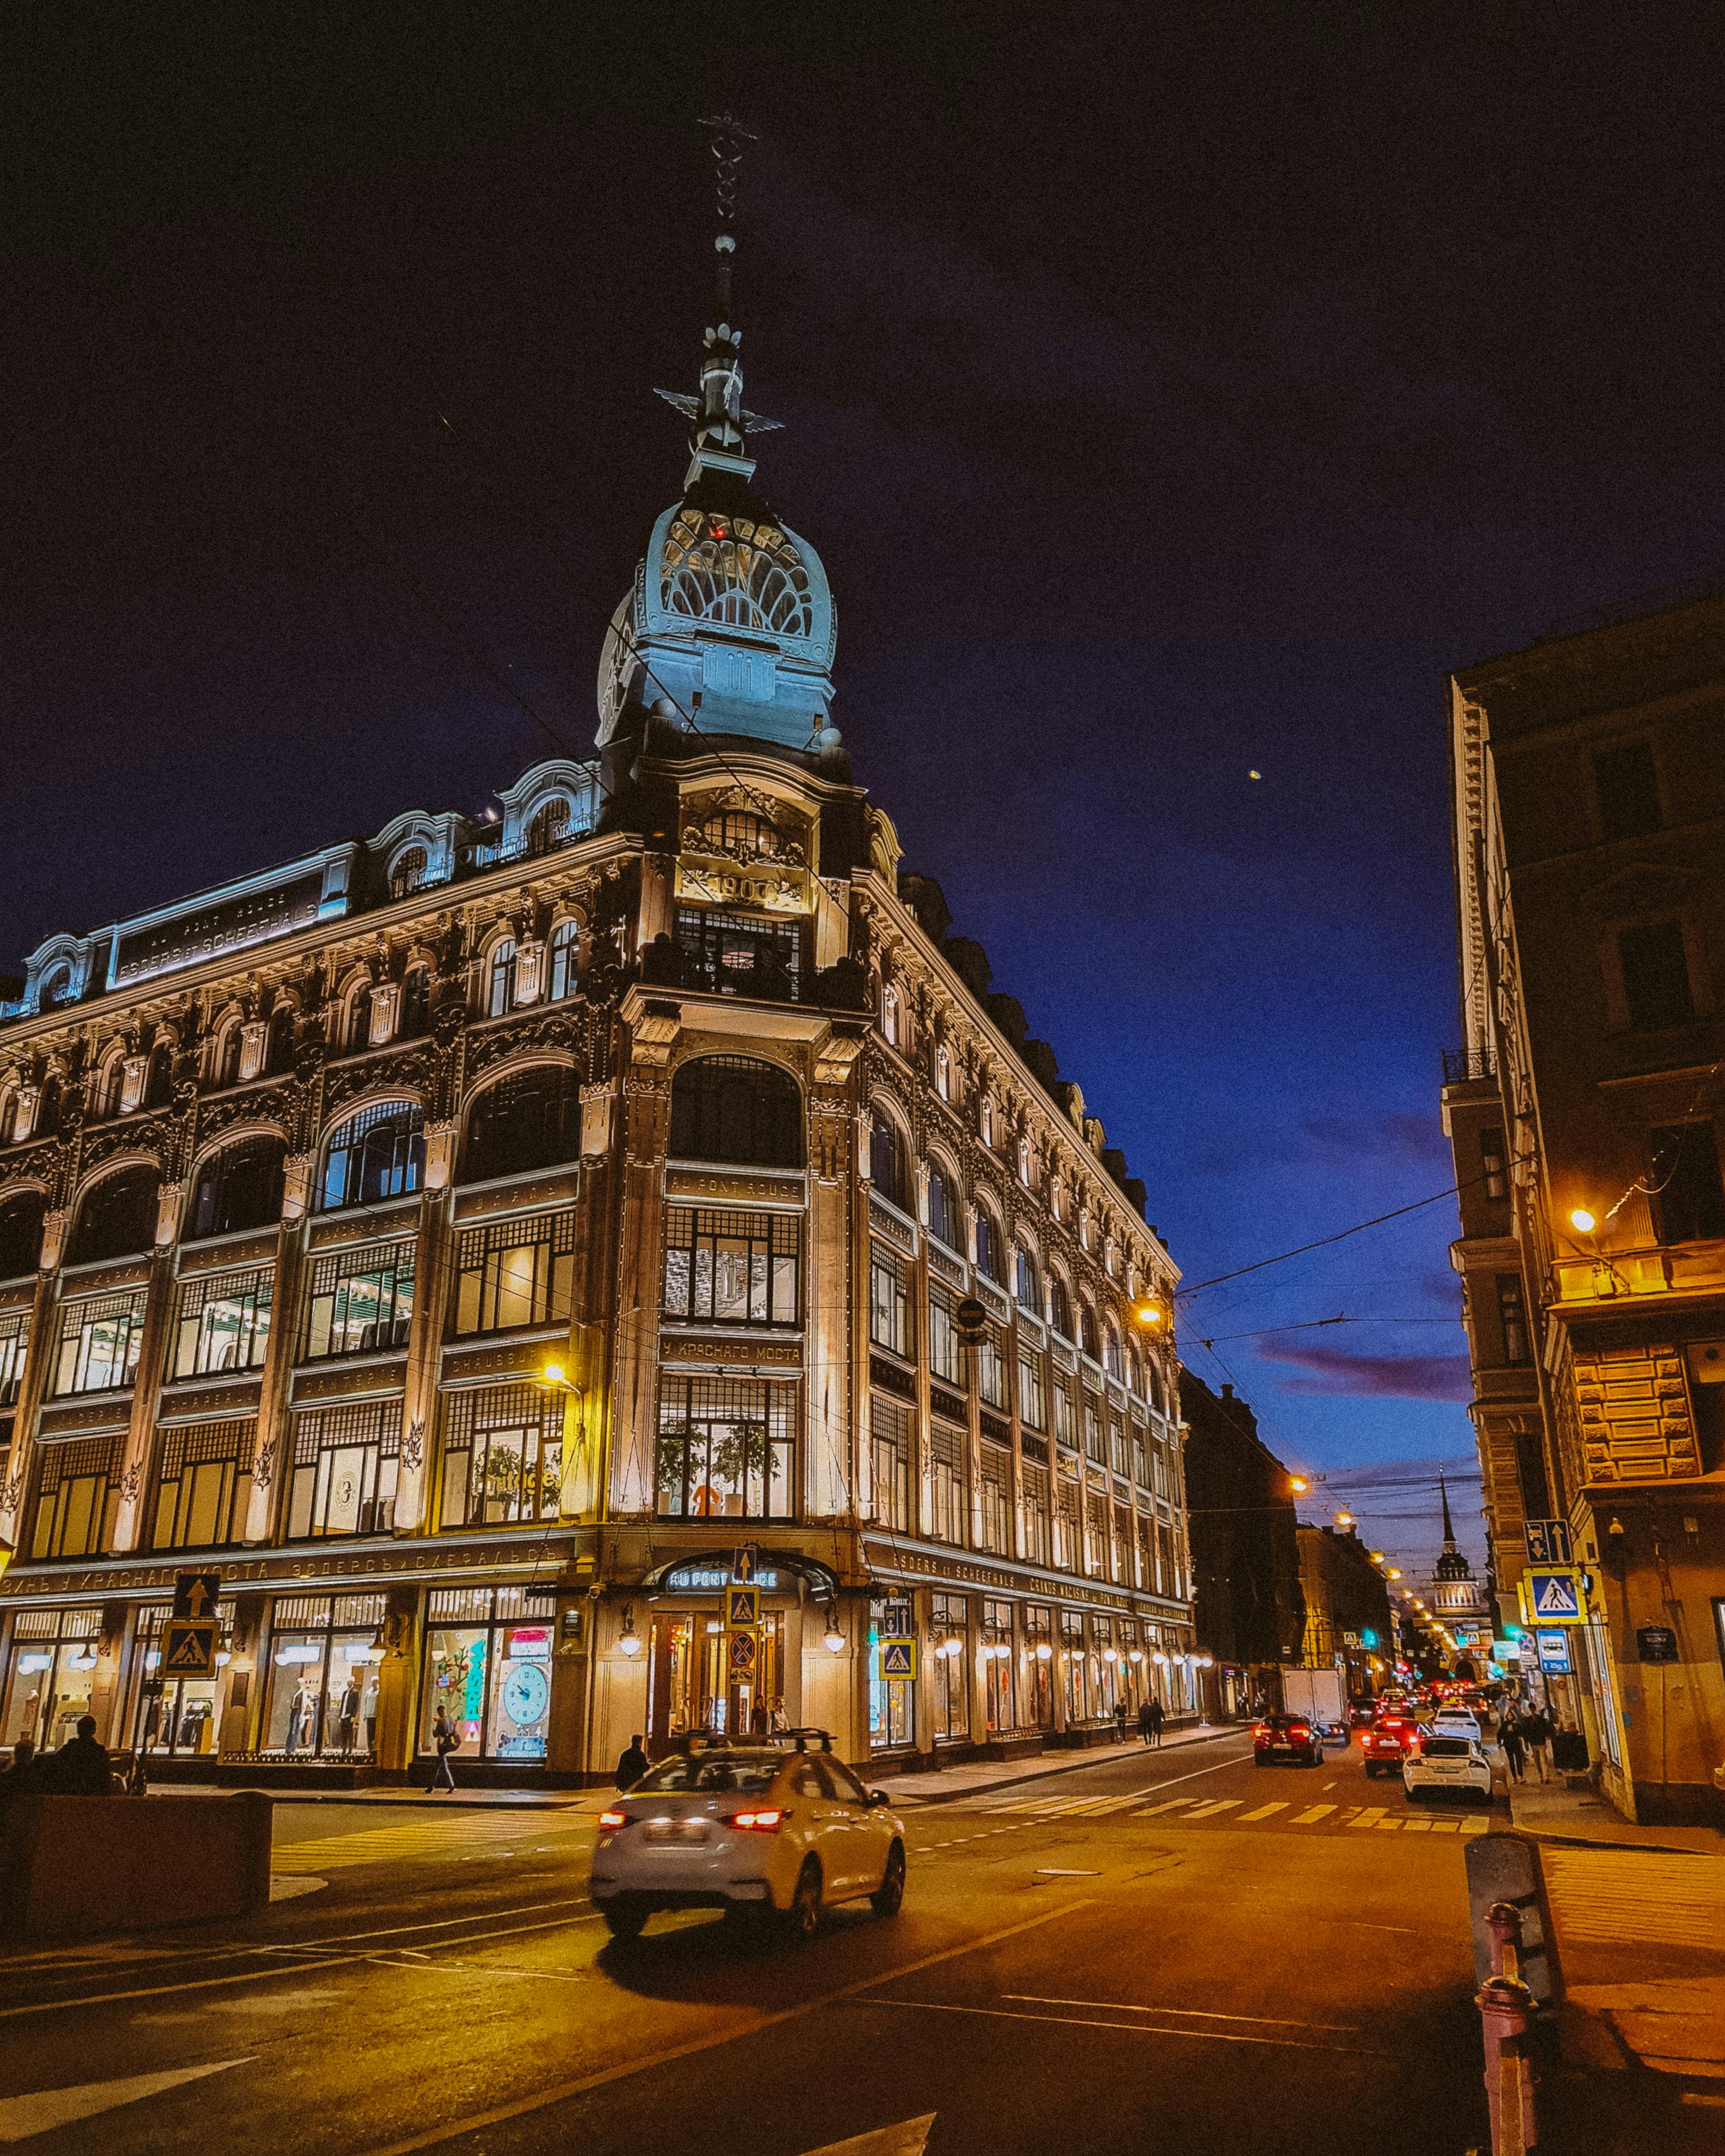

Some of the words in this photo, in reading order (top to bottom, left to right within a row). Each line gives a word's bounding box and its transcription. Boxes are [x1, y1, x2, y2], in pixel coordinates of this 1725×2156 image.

[713, 877, 770, 900] 1907
[119, 948, 182, 980] ESDERS
[186, 945, 199, 960] ET
[202, 904, 316, 954] SCHEEFHALS
[671, 1177, 690, 1189] AU
[698, 1179, 738, 1193] PONT
[746, 1183, 799, 1198] ROUGE
[663, 1342, 671, 1354] У
[678, 1342, 749, 1358] КРАСНАГО
[756, 1346, 800, 1361] МОСТА
[292, 1558, 392, 1576] ЭСДЕРСЪ
[416, 1548, 556, 1568] СХЕФАЛЬСЪ
[893, 1553, 937, 1574] ESDERS
[956, 1565, 1015, 1587] SCHEEFHALS
[61, 1576, 71, 1591] У
[669, 1571, 690, 1586] AU
[691, 1571, 728, 1586] PONT
[1030, 1578, 1056, 1596] GRANDS
[1060, 1582, 1089, 1602] MAGASINS
